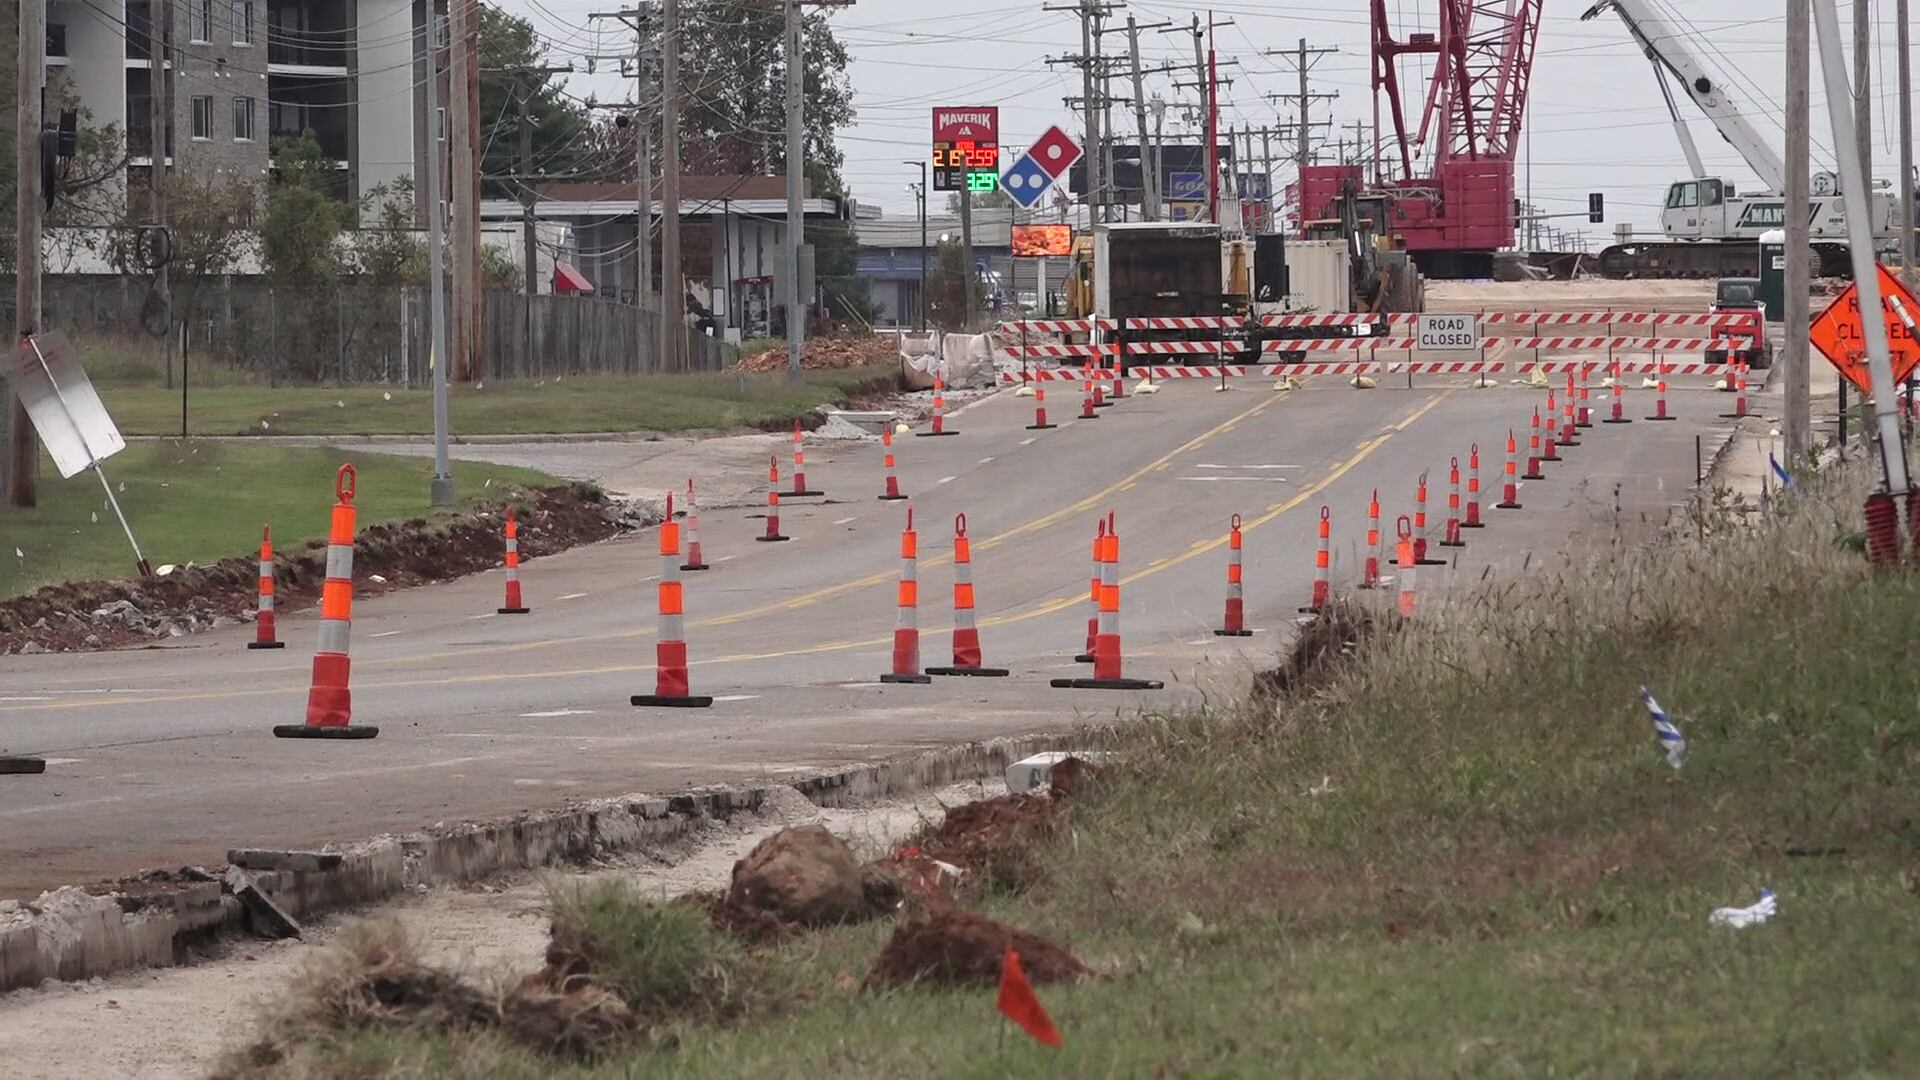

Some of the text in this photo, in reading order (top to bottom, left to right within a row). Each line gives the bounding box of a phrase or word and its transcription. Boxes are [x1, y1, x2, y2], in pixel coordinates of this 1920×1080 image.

[939, 113, 991, 130] MAVERIK
[1751, 208, 1785, 222] MAN
[1429, 319, 1464, 330] ROAD
[1838, 323, 1913, 339] CLED
[1422, 334, 1471, 345] CLOSED
